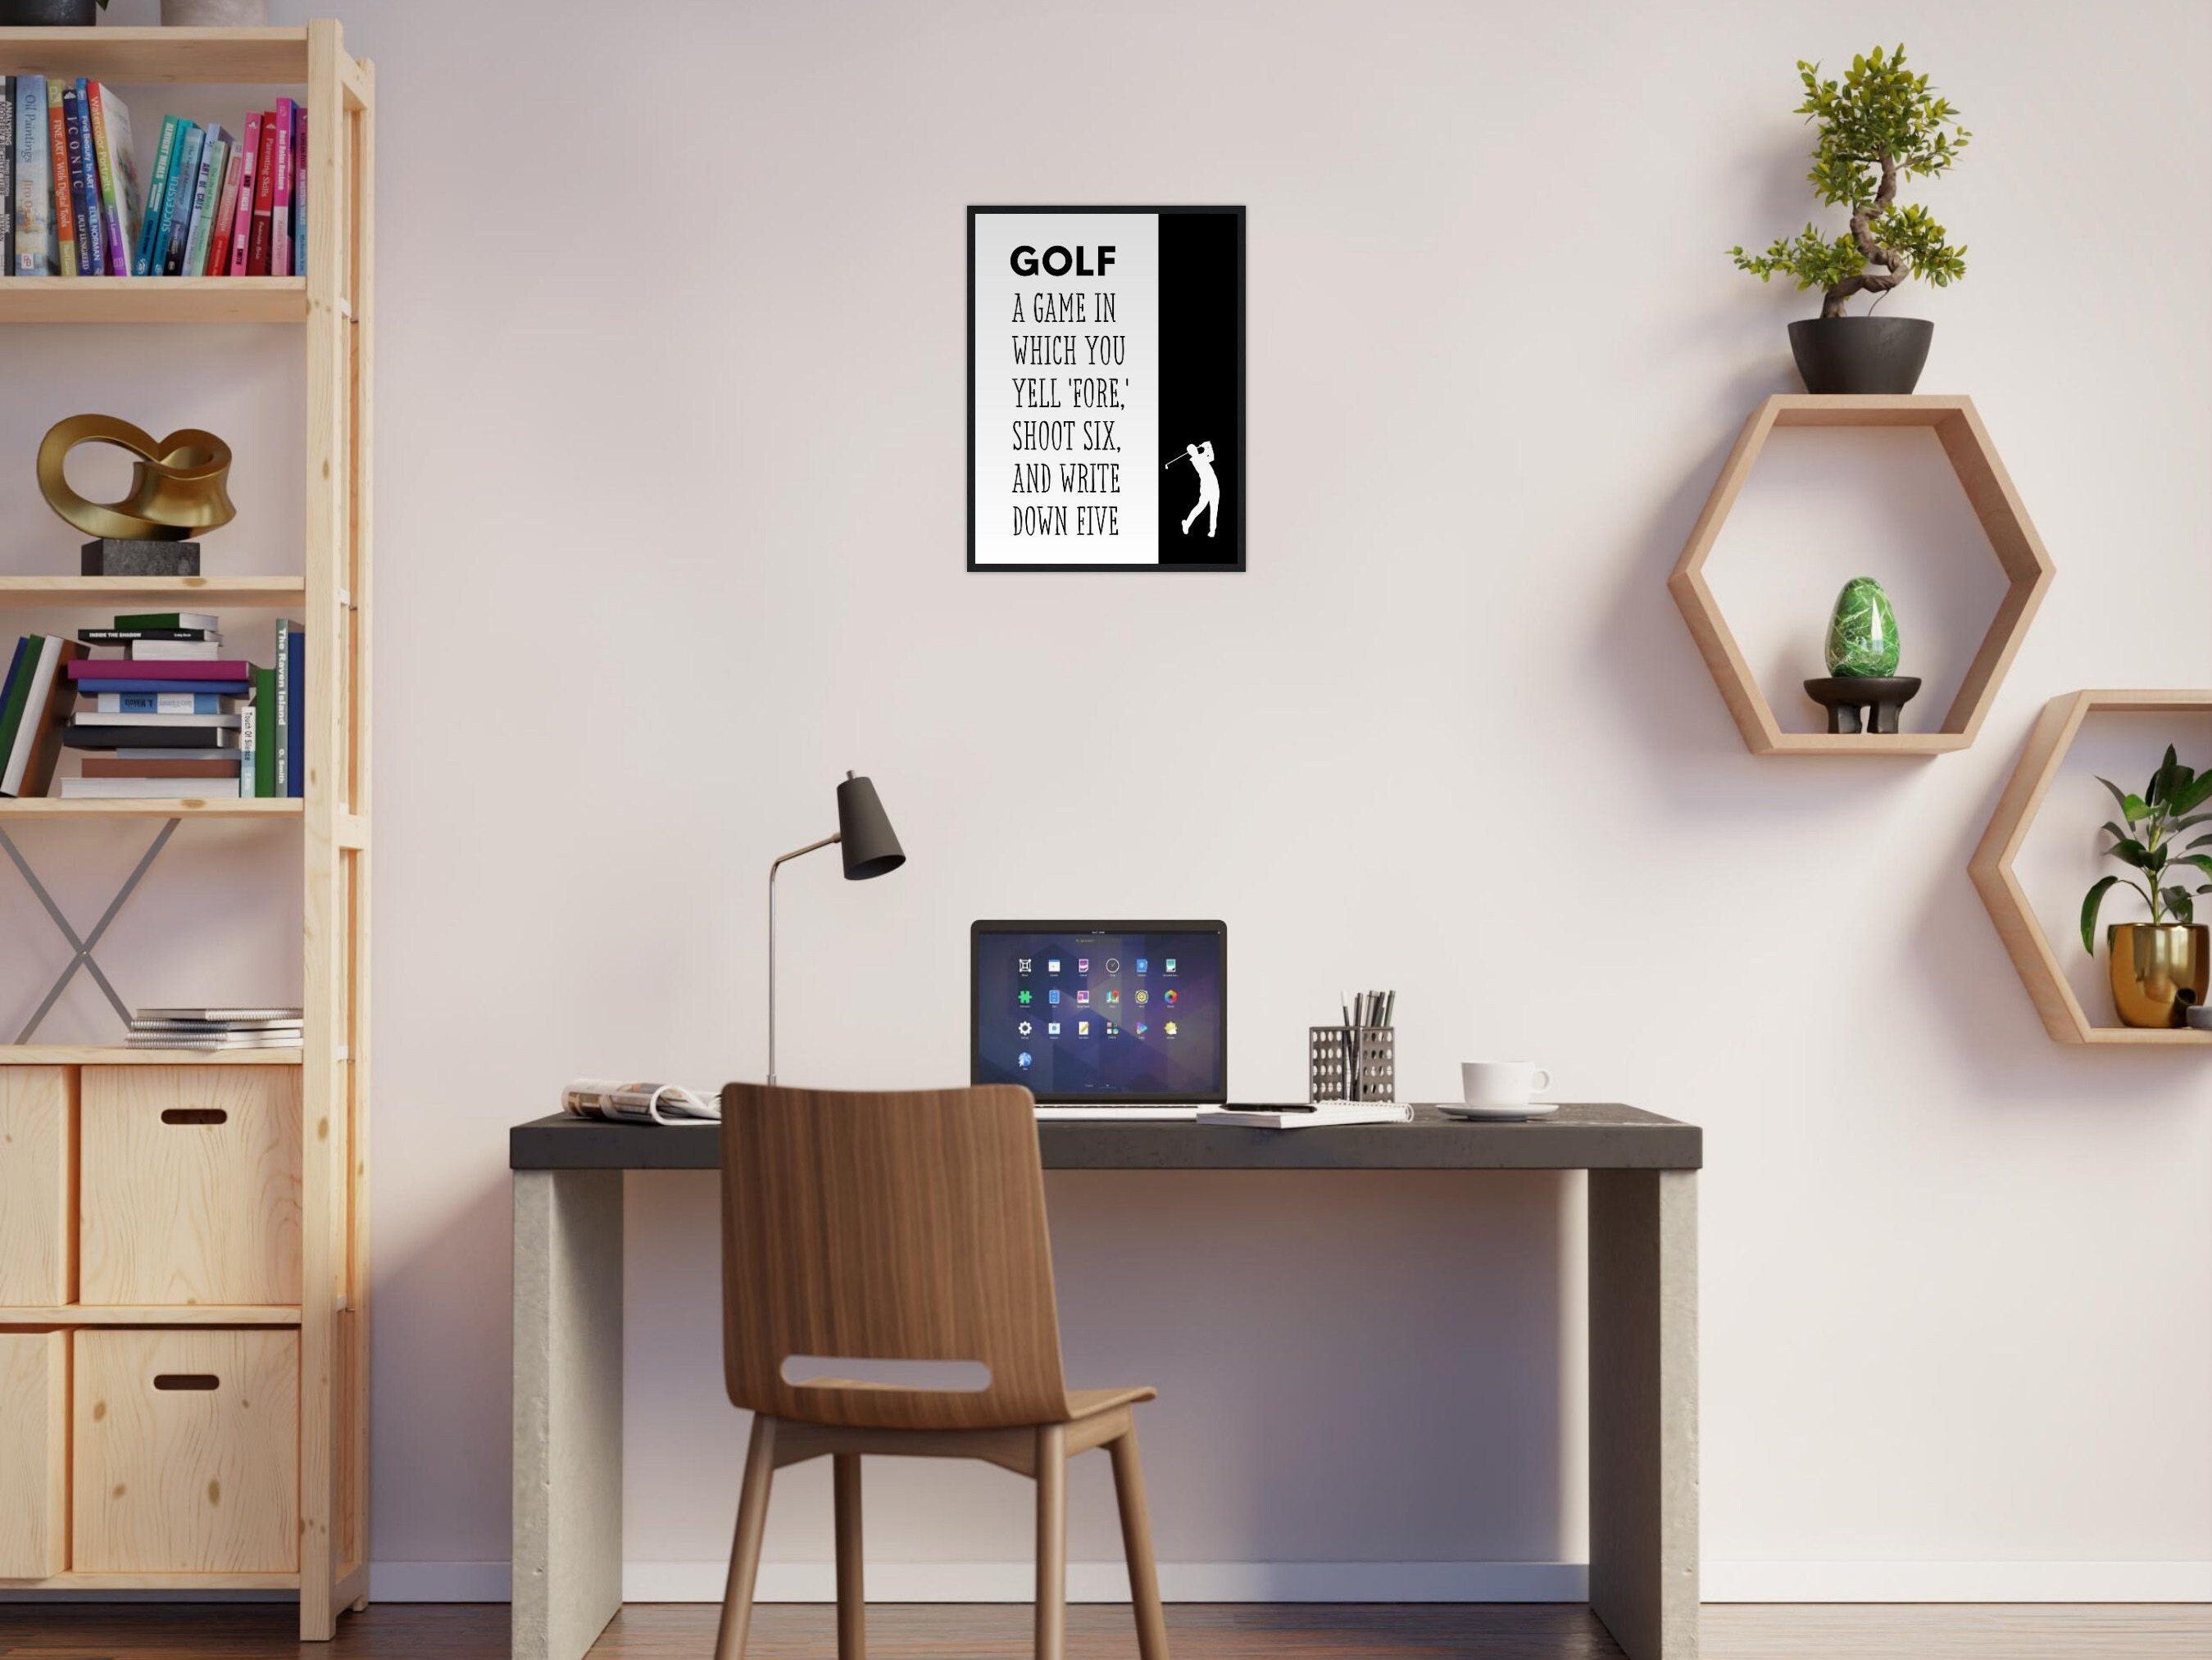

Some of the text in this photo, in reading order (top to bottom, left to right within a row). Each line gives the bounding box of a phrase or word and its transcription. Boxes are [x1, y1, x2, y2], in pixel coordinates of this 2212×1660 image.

[20, 94, 37, 163] Oil Paintings
[53, 119, 62, 138] FINE
[54, 139, 64, 155] ART
[91, 97, 111, 192] Watercolor Portraits
[57, 162, 66, 180] With
[81, 133, 91, 161] Beauty
[86, 173, 94, 189] ART
[156, 155, 168, 179] MEALS
[201, 163, 210, 176] ART
[261, 138, 274, 197] Parenting Skills
[22, 179, 33, 198] Jiro
[243, 175, 252, 188] AND
[277, 164, 285, 190] Restore
[56, 182, 68, 209] Digital
[161, 175, 179, 233] SUCCESSFUL
[194, 193, 205, 210] CATS
[241, 188, 252, 211] FITNESS
[61, 209, 71, 228] Tools
[89, 206, 101, 261] ELLE NORMAN
[235, 248, 243, 265] SMITH
[1011, 246, 1115, 276] GOLF
[1012, 293, 1115, 323] A GAME IN
[1012, 336, 1125, 365] WHICH YOU
[1012, 378, 1129, 410] YELL 'FORE,'
[1013, 421, 1121, 452] SHOOT SIX,
[1012, 464, 1120, 493] AND WRITE
[1013, 506, 1118, 536] DOWN FIVE
[279, 653, 287, 688] Raven
[279, 691, 287, 725] Island
[243, 711, 252, 760] Touch Of Silence
[279, 748, 285, 758] O.
